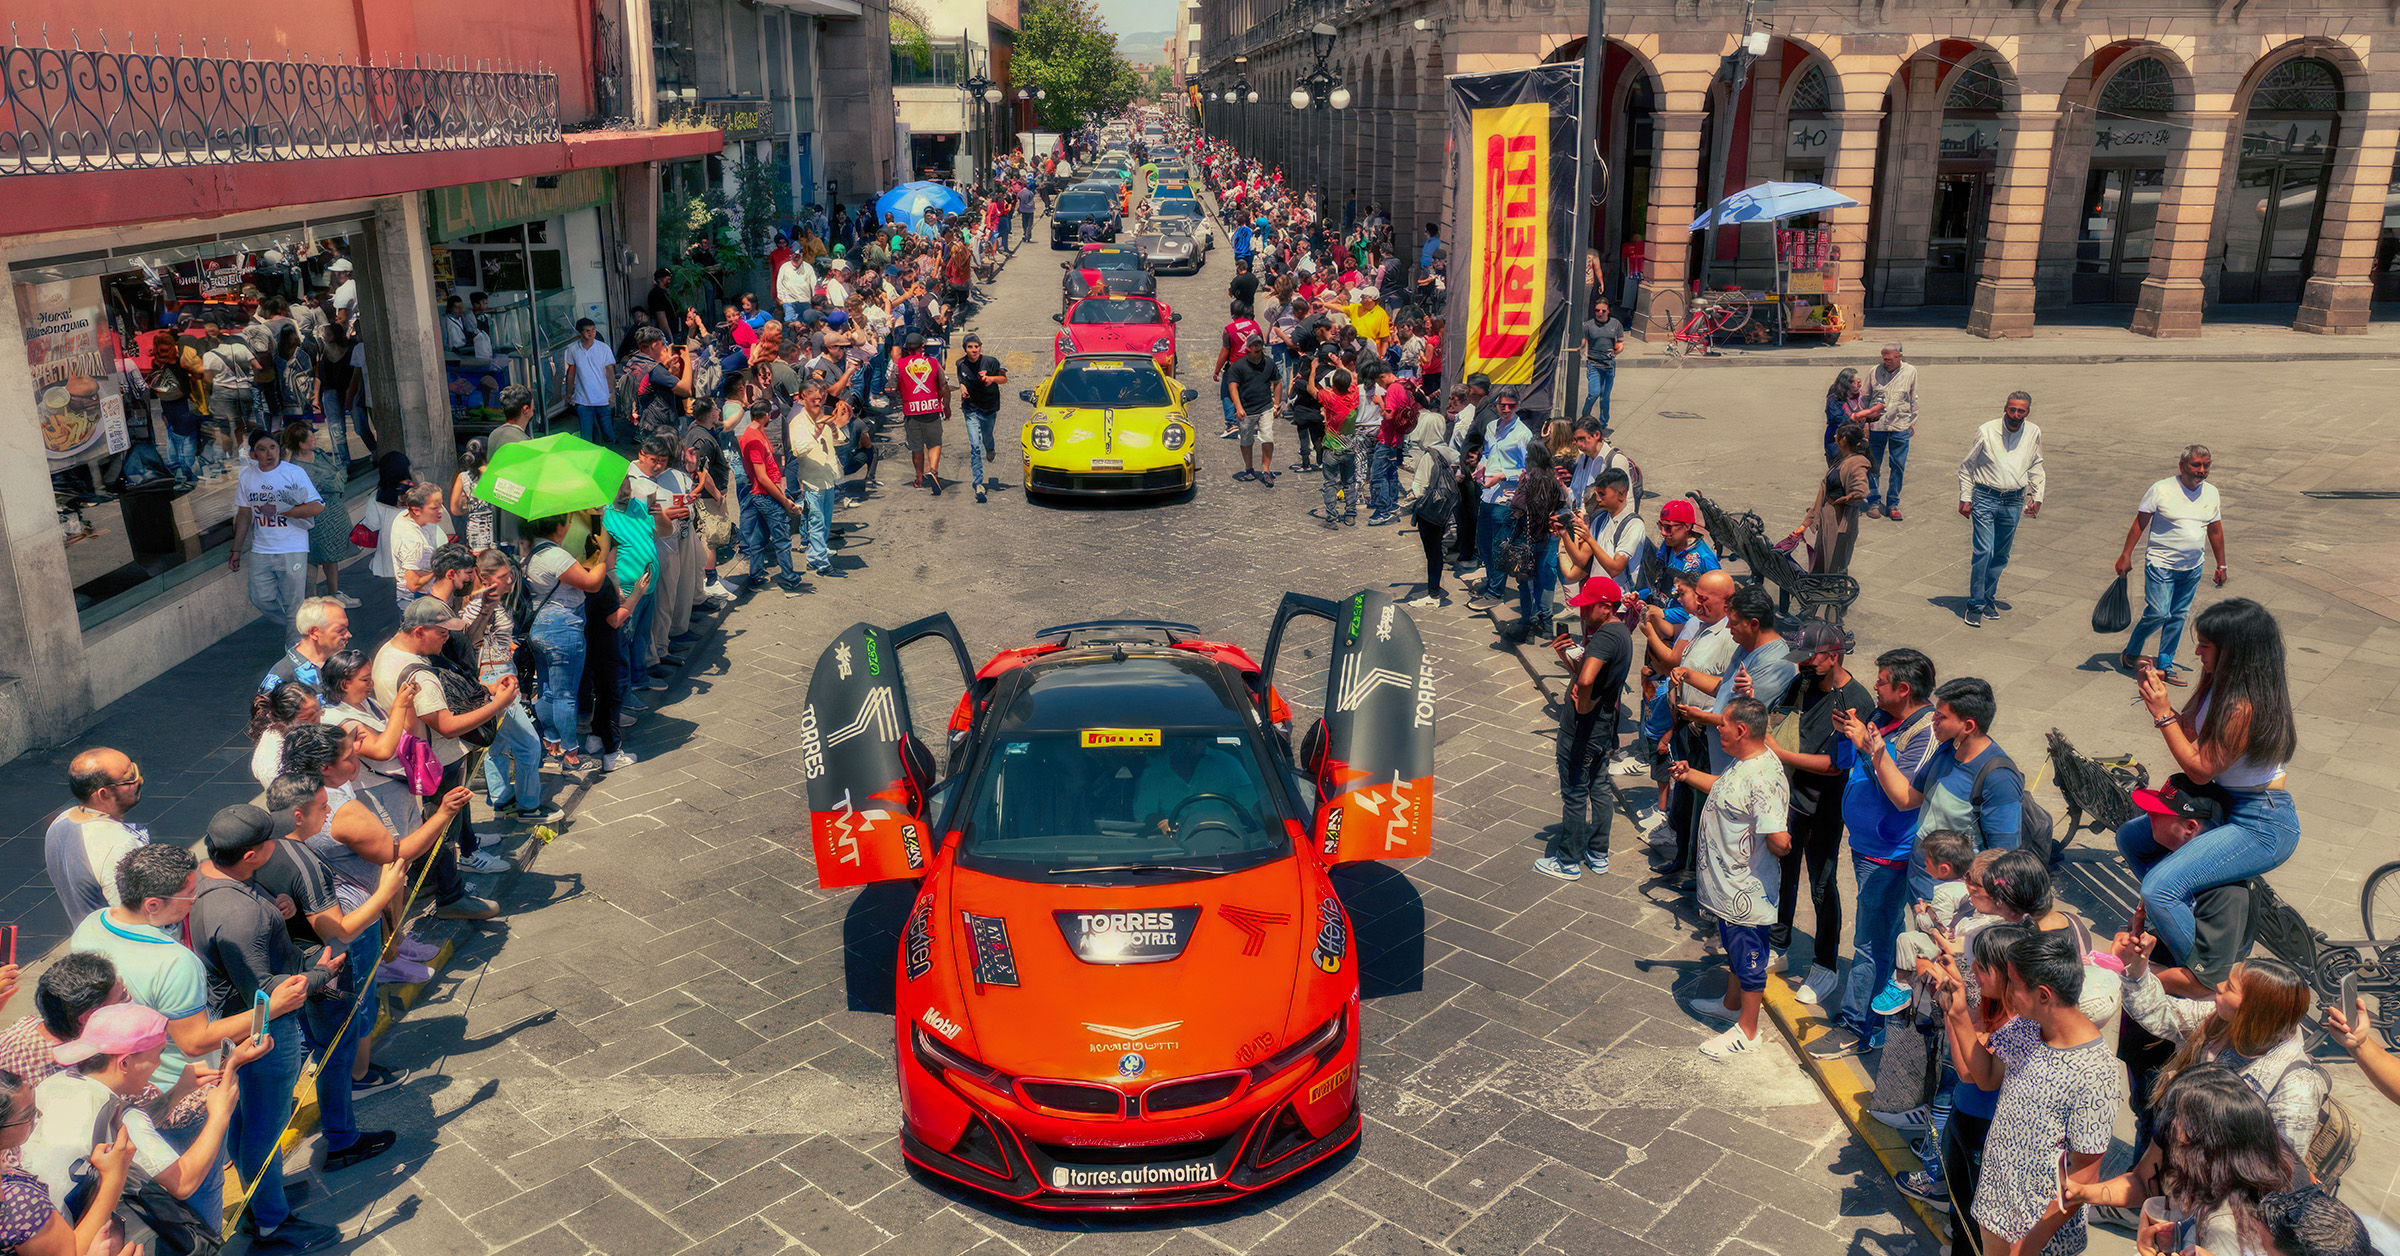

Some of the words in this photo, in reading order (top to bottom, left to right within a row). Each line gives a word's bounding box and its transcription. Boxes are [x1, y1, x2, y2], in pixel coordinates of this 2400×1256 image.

[1478, 133, 1537, 359] PIRELLI
[800, 703, 825, 780] TORRES
[831, 788, 861, 867] TWT
[1385, 769, 1413, 851] TWT
[1077, 912, 1174, 934] TORRES
